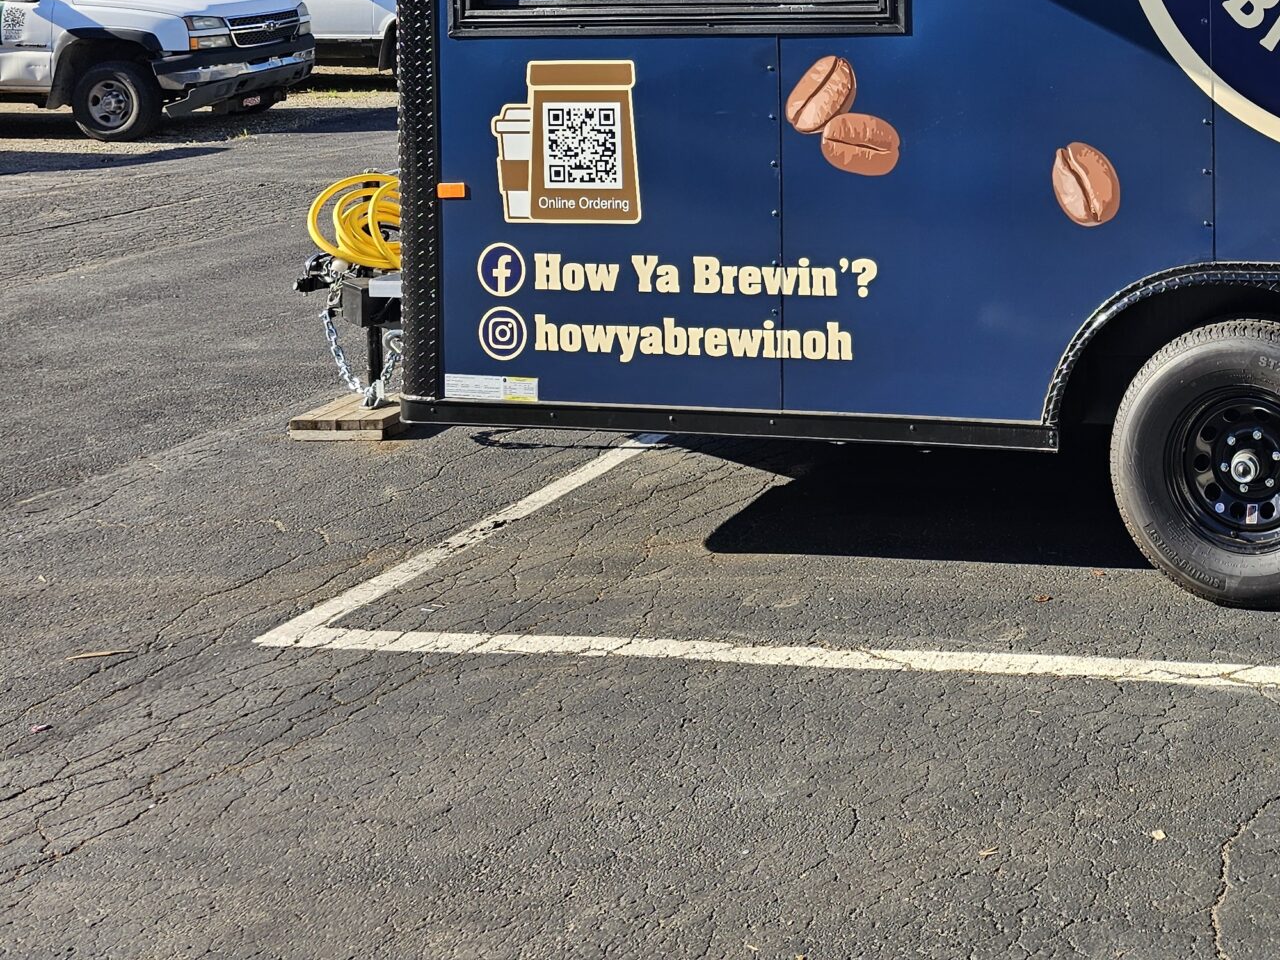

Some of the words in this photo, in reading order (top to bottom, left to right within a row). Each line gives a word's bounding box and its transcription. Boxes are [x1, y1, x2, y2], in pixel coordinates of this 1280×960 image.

[538, 196, 575, 209] Online
[578, 197, 630, 212] Ordering
[534, 253, 620, 292] How
[631, 254, 680, 294] Ya
[692, 255, 878, 298] Brewin'?
[534, 313, 853, 363] howyabrewinoh
